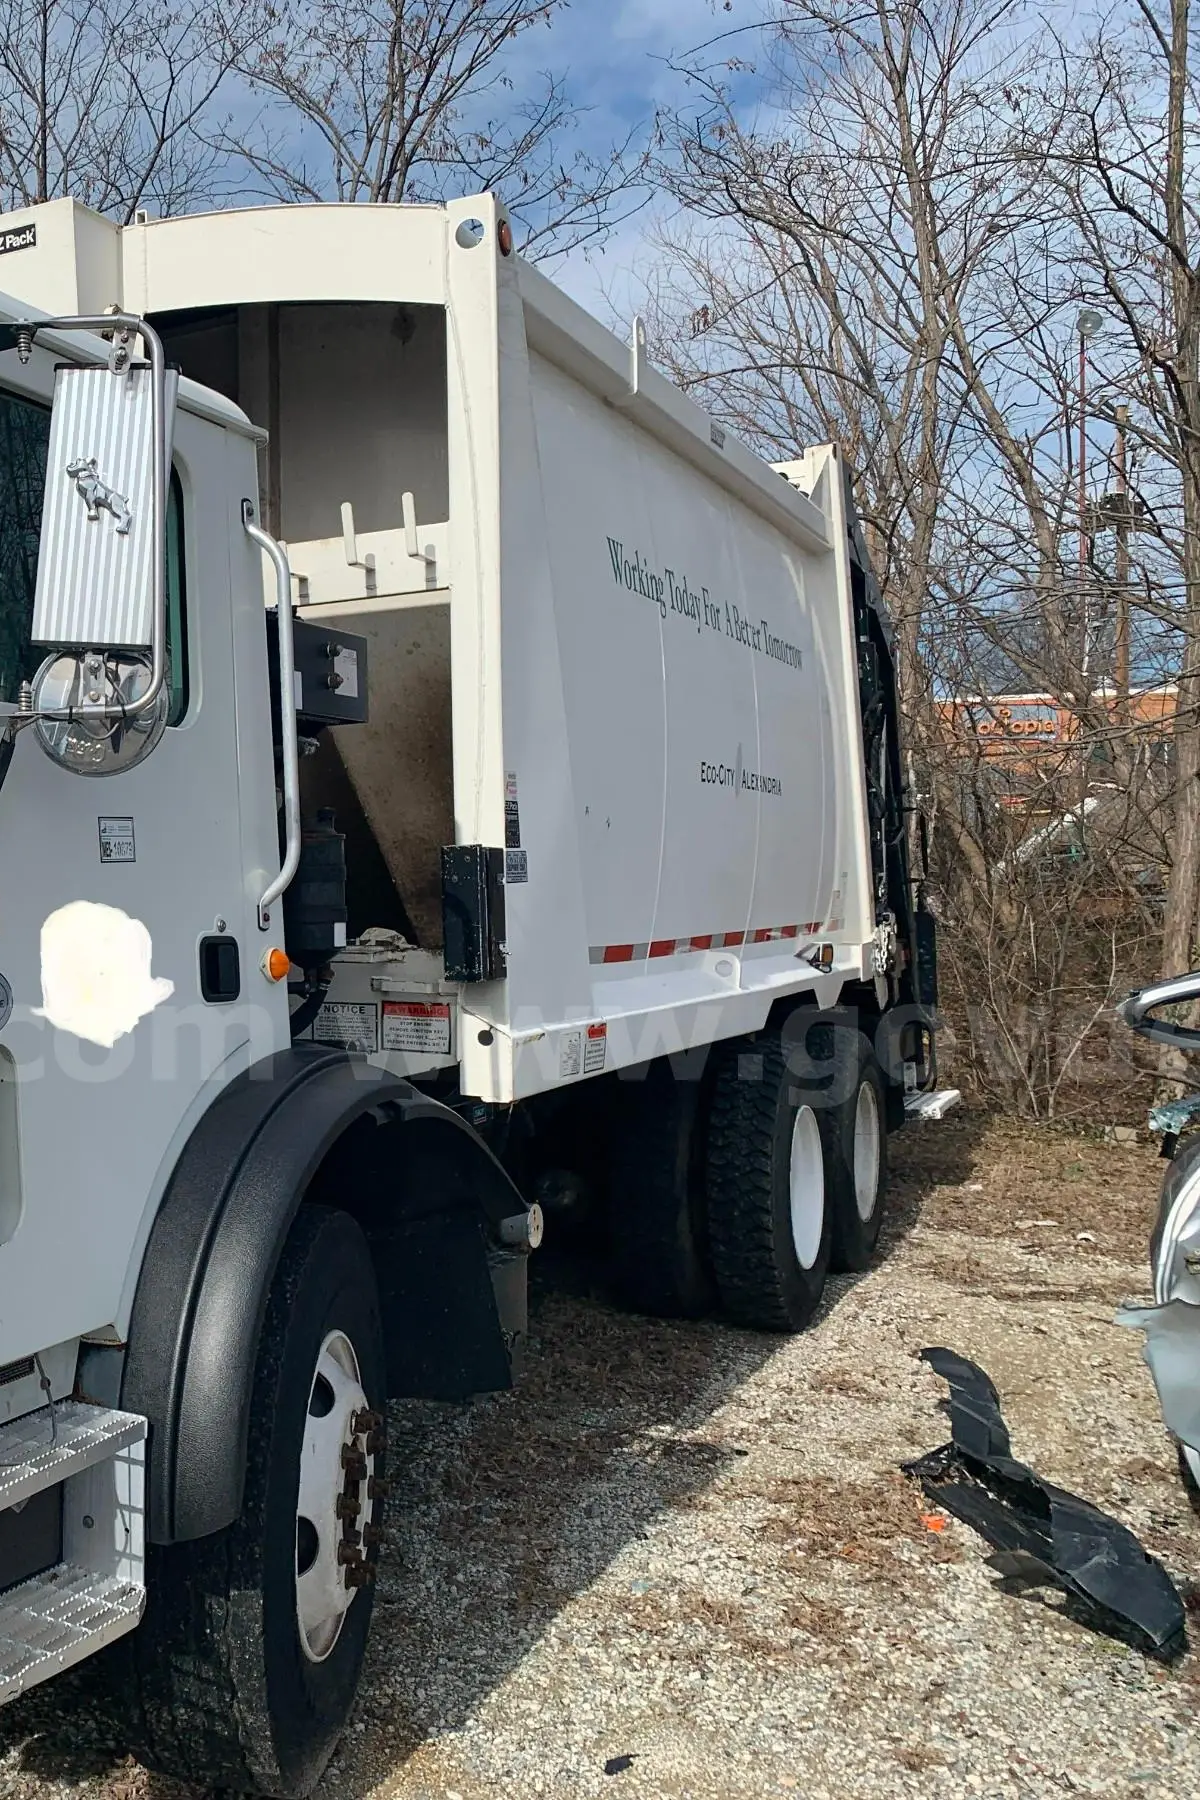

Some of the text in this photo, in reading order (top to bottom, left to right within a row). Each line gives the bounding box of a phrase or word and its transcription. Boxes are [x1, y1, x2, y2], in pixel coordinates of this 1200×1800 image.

[5, 228, 35, 249] Pack
[606, 535, 803, 670] Working Today For A Beter Tomorrow
[323, 1004, 366, 1014] NOTICE
